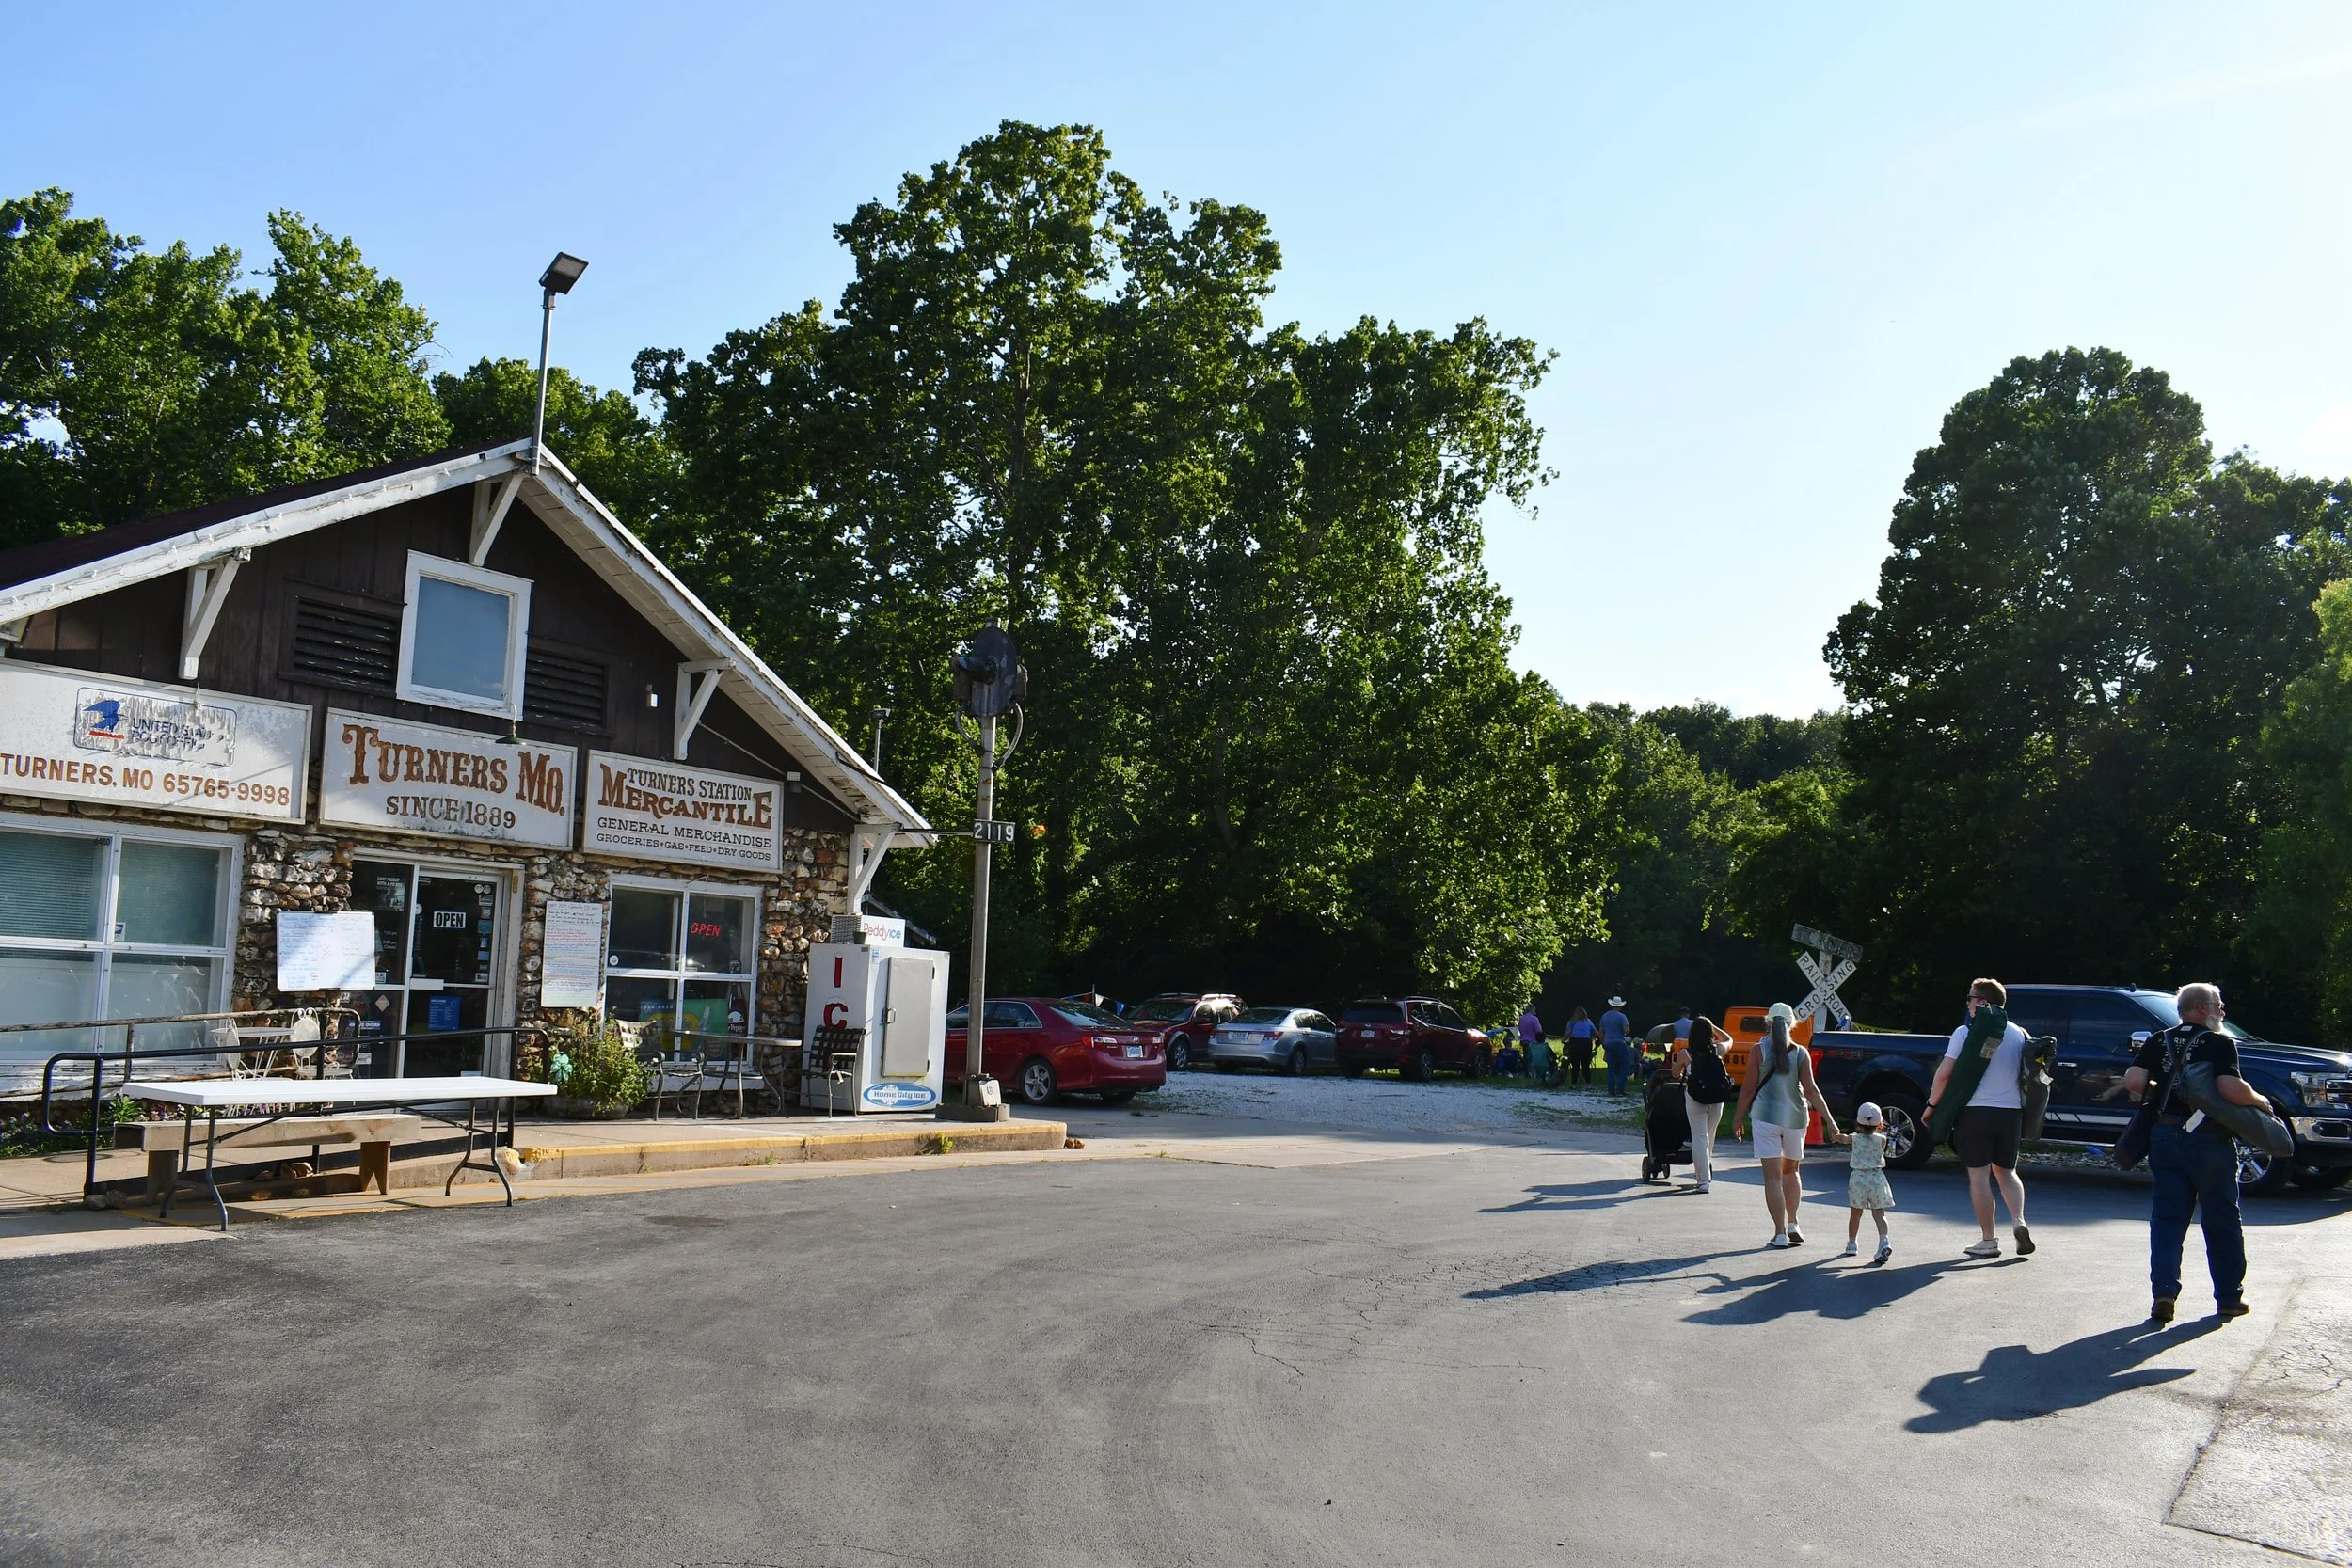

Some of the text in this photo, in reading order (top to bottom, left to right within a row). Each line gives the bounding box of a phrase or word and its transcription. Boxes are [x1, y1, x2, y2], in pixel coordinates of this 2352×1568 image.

[342, 723, 508, 794] TURNERS
[123, 768, 153, 791] MO
[163, 773, 290, 806] 65765-9998
[597, 763, 772, 829] MERCANTILE
[627, 768, 752, 800] TURNERS STATION
[386, 796, 516, 829] SINCE 1889
[597, 817, 771, 848] GENERAL MERCHANDISE
[974, 822, 1014, 842] 2119
[718, 847, 737, 857] DRY
[739, 850, 771, 861] GOODS
[435, 912, 464, 927] OPEN
[691, 922, 722, 937] OPEN
[1798, 961, 1853, 1019] CROSSING
